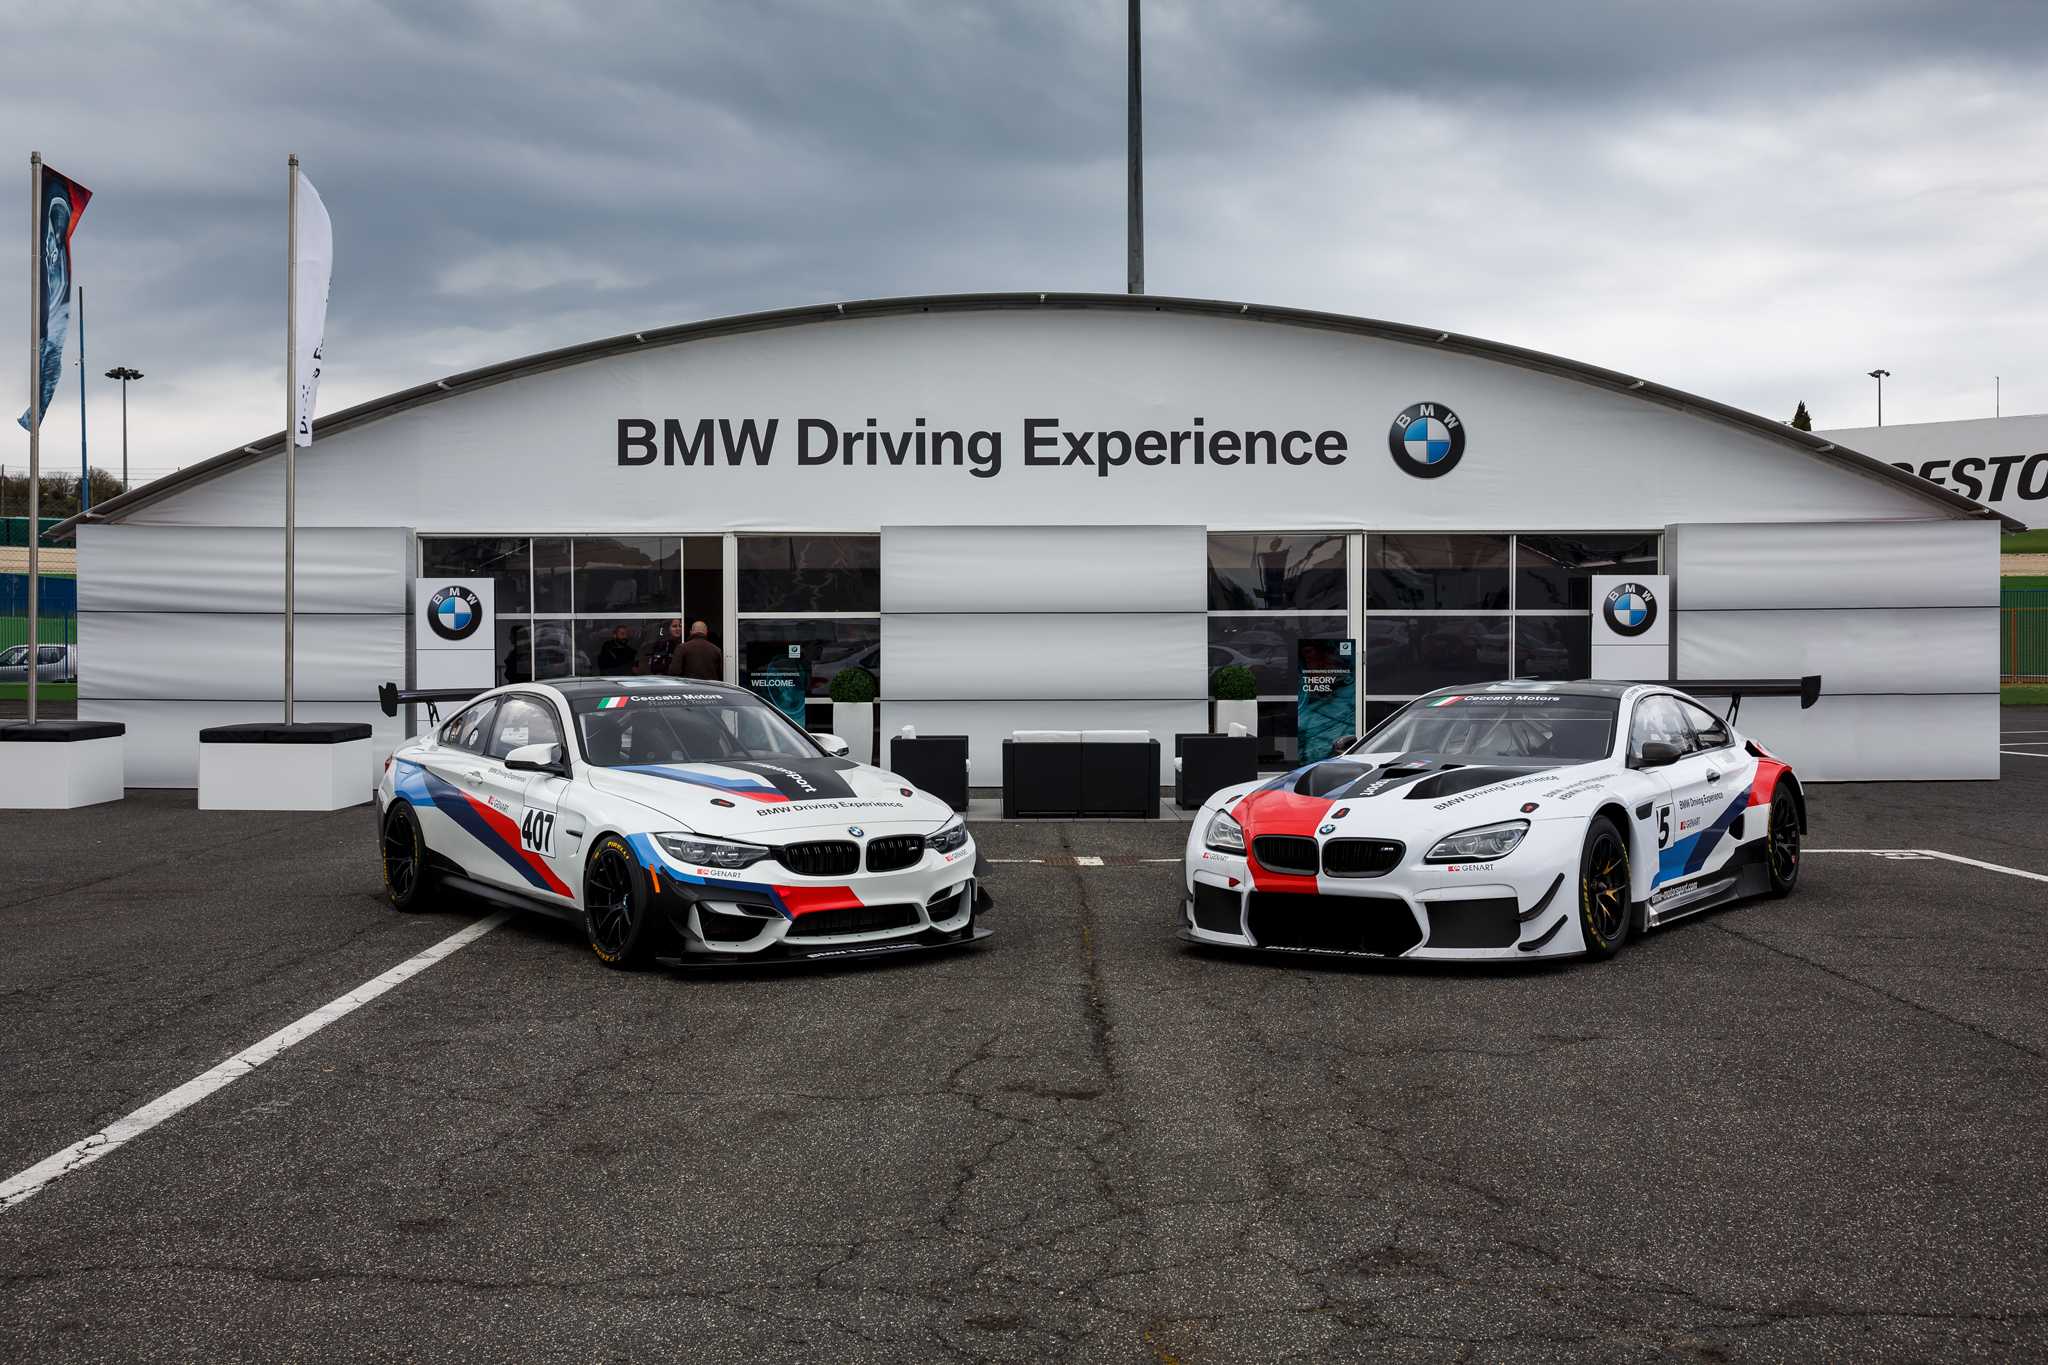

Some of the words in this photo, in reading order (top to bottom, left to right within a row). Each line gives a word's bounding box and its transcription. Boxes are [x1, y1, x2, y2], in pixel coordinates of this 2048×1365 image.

[617, 418, 779, 466] BMW
[798, 417, 1002, 478] Driving
[1023, 417, 1348, 477] Experience
[1890, 453, 2048, 502] ESTO
[751, 679, 796, 687] WELCOME.
[1302, 676, 1336, 684] THEORY
[1433, 795, 1466, 811] BMW
[1463, 785, 1506, 800] Driving
[1504, 775, 1560, 791] Experience
[1679, 800, 1691, 810] BMW
[1690, 796, 1704, 807] Driving
[1704, 792, 1724, 804] Experience
[756, 806, 791, 817] BMW
[793, 803, 839, 813] Driving
[839, 800, 904, 810] Experience
[522, 809, 555, 853] 407
[710, 869, 741, 878] GENART
